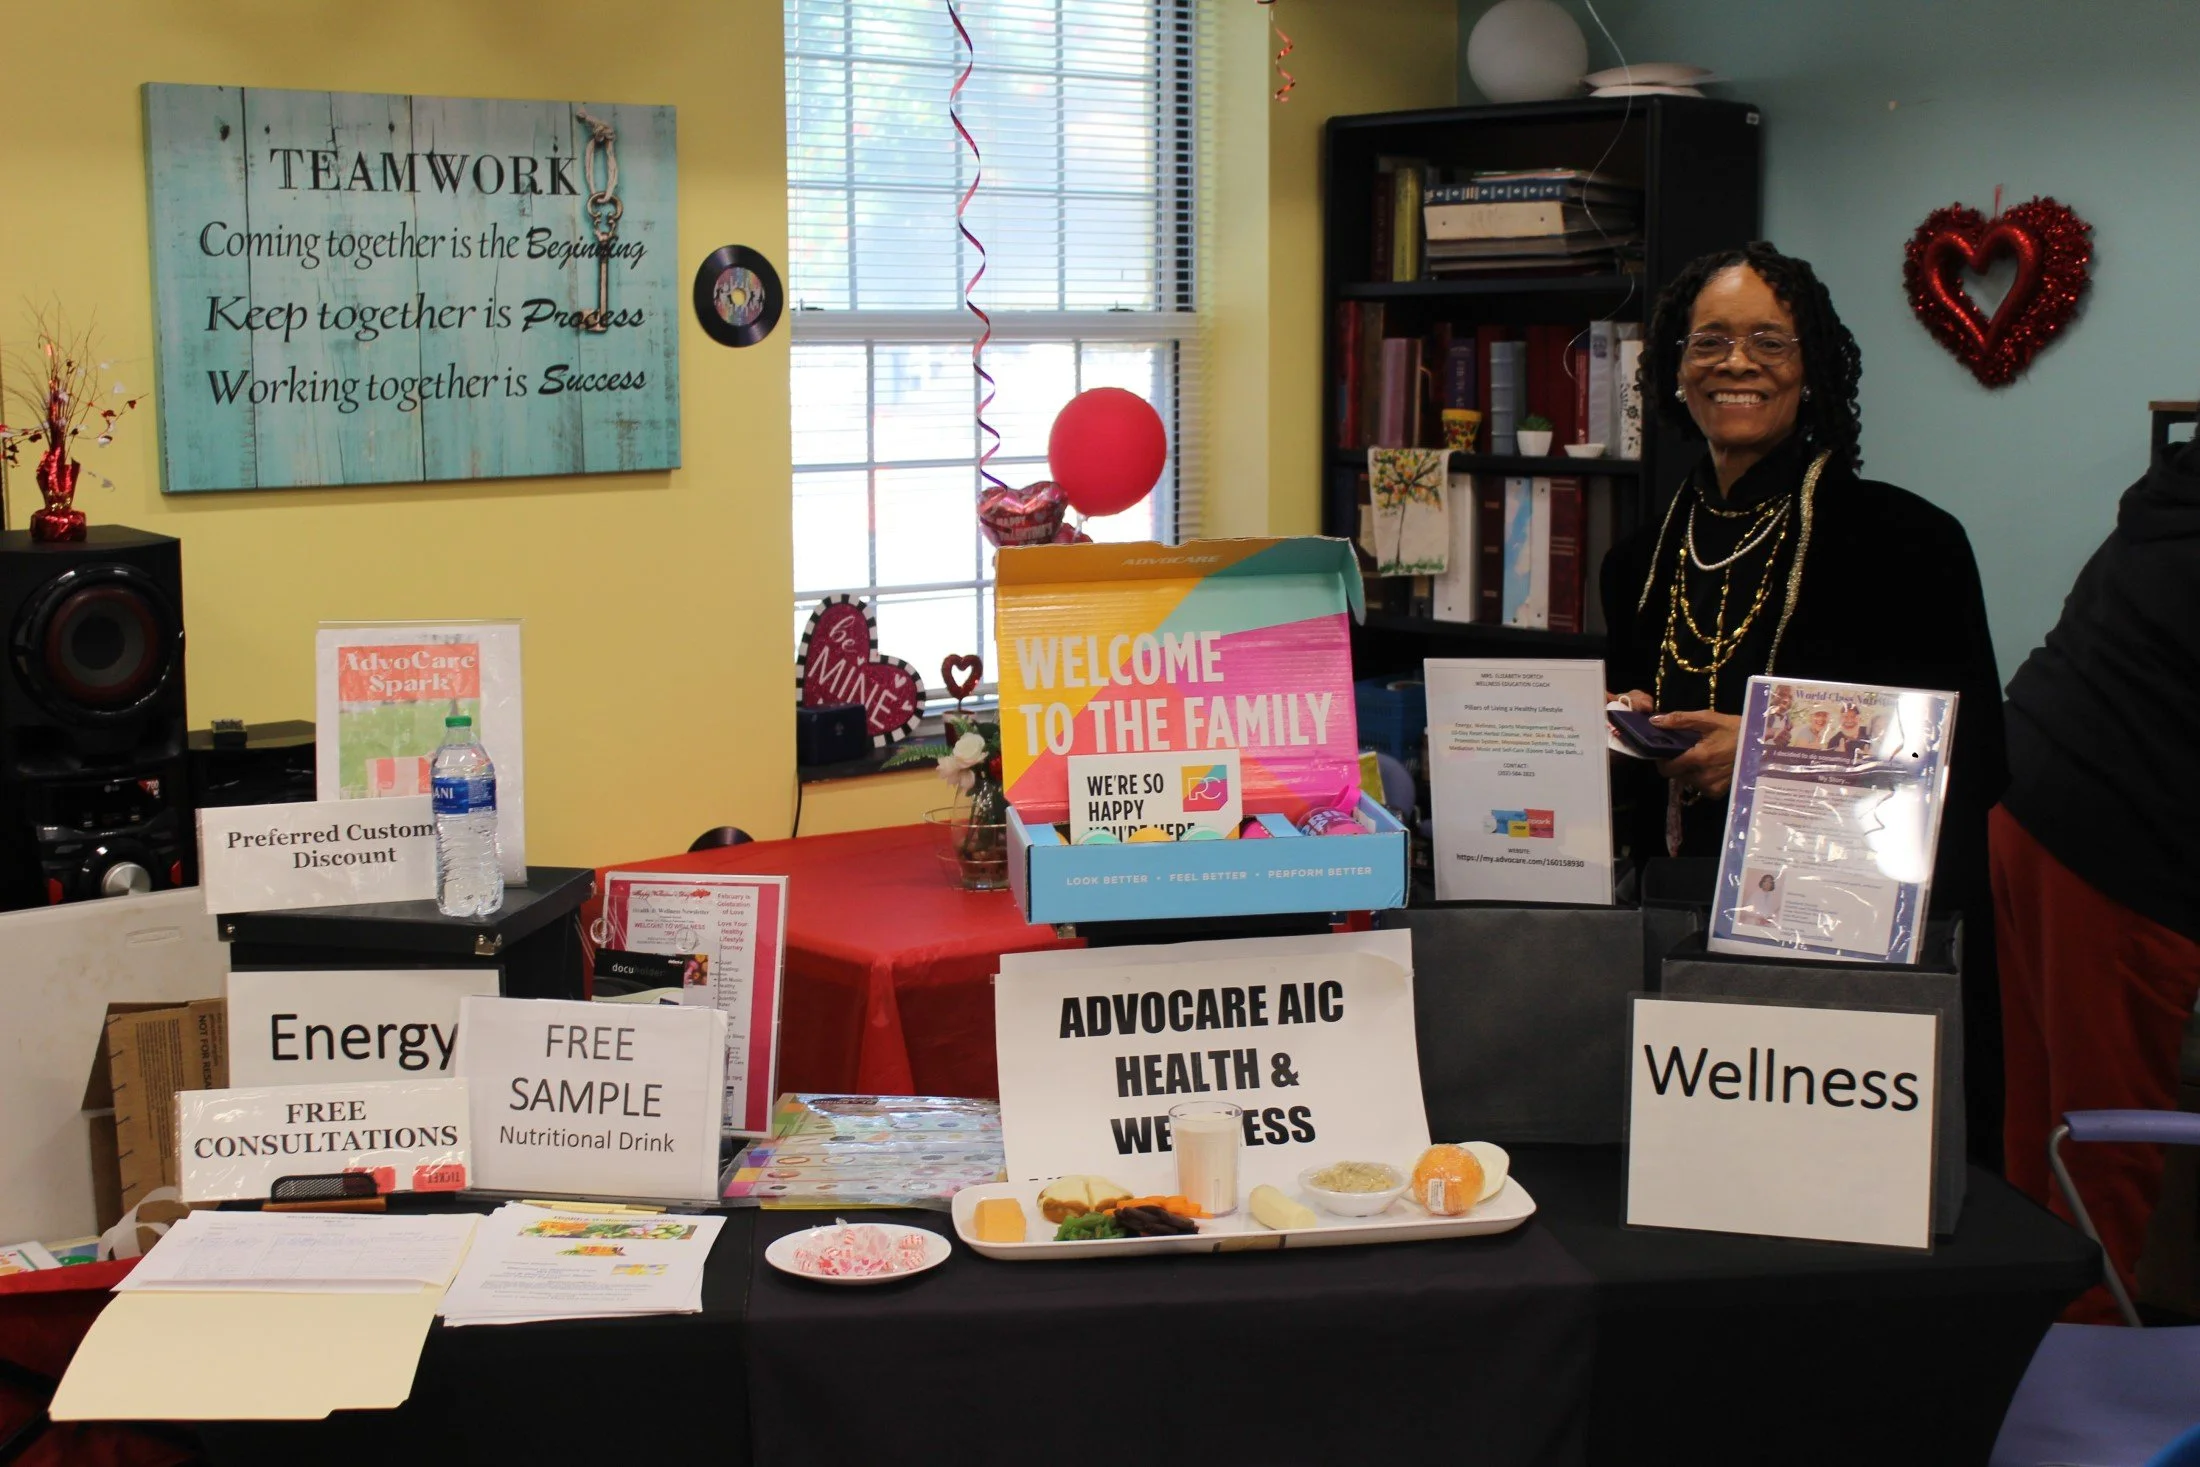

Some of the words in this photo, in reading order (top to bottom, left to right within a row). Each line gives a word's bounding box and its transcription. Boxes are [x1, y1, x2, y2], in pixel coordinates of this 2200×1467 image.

[270, 148, 581, 197] TEAMWORK
[199, 221, 320, 270] Coming
[326, 222, 446, 269] together
[451, 225, 472, 260] is
[479, 222, 520, 260] the
[526, 227, 648, 269] Beginning
[205, 295, 308, 342] Keep
[318, 292, 470, 341] together
[486, 297, 512, 330] is
[521, 298, 646, 332] Process
[207, 365, 360, 413] Working
[367, 364, 498, 412] together
[503, 366, 528, 397] is
[538, 364, 647, 395] Success
[829, 615, 856, 653] be
[344, 650, 477, 671] AdvoCare
[1015, 631, 1225, 690] WELCOME
[807, 645, 898, 730] MINE
[1019, 703, 1074, 756] TO
[1088, 698, 1170, 753] THE
[1184, 692, 1333, 750] FAMILY
[433, 787, 454, 799] ANI
[1087, 774, 1138, 797] WE'RE
[1143, 773, 1164, 794] SO
[1088, 799, 1144, 822] HAPPY
[228, 824, 340, 849] Preferred
[346, 823, 435, 842] Custom
[293, 847, 397, 869] Discount
[1066, 876, 1099, 886] LOOK
[1103, 874, 1149, 884] BETTER
[1169, 872, 1198, 882] FEEL
[1202, 871, 1247, 880] BETTER
[1268, 868, 1324, 878] PERFORM
[1328, 866, 1373, 876] BETTER
[198, 1015, 208, 1036] NOT
[1060, 985, 1268, 1039] ADVOCARE
[1278, 980, 1344, 1025] AIC
[201, 1039, 210, 1060] FOR
[271, 1012, 458, 1071] Energy
[546, 1024, 635, 1062] FREE
[203, 1062, 213, 1089] RESA
[1115, 1048, 1261, 1098] HEALTH
[1270, 1052, 1300, 1088] &
[1644, 1044, 1919, 1112] Wellness
[285, 1100, 367, 1126] FREE
[510, 1077, 663, 1119] SAMPLE
[194, 1125, 459, 1160] CONSULTATIONS
[500, 1125, 612, 1151] Nutritional
[619, 1129, 674, 1153] Drink
[1110, 1105, 1316, 1155] WEESS
